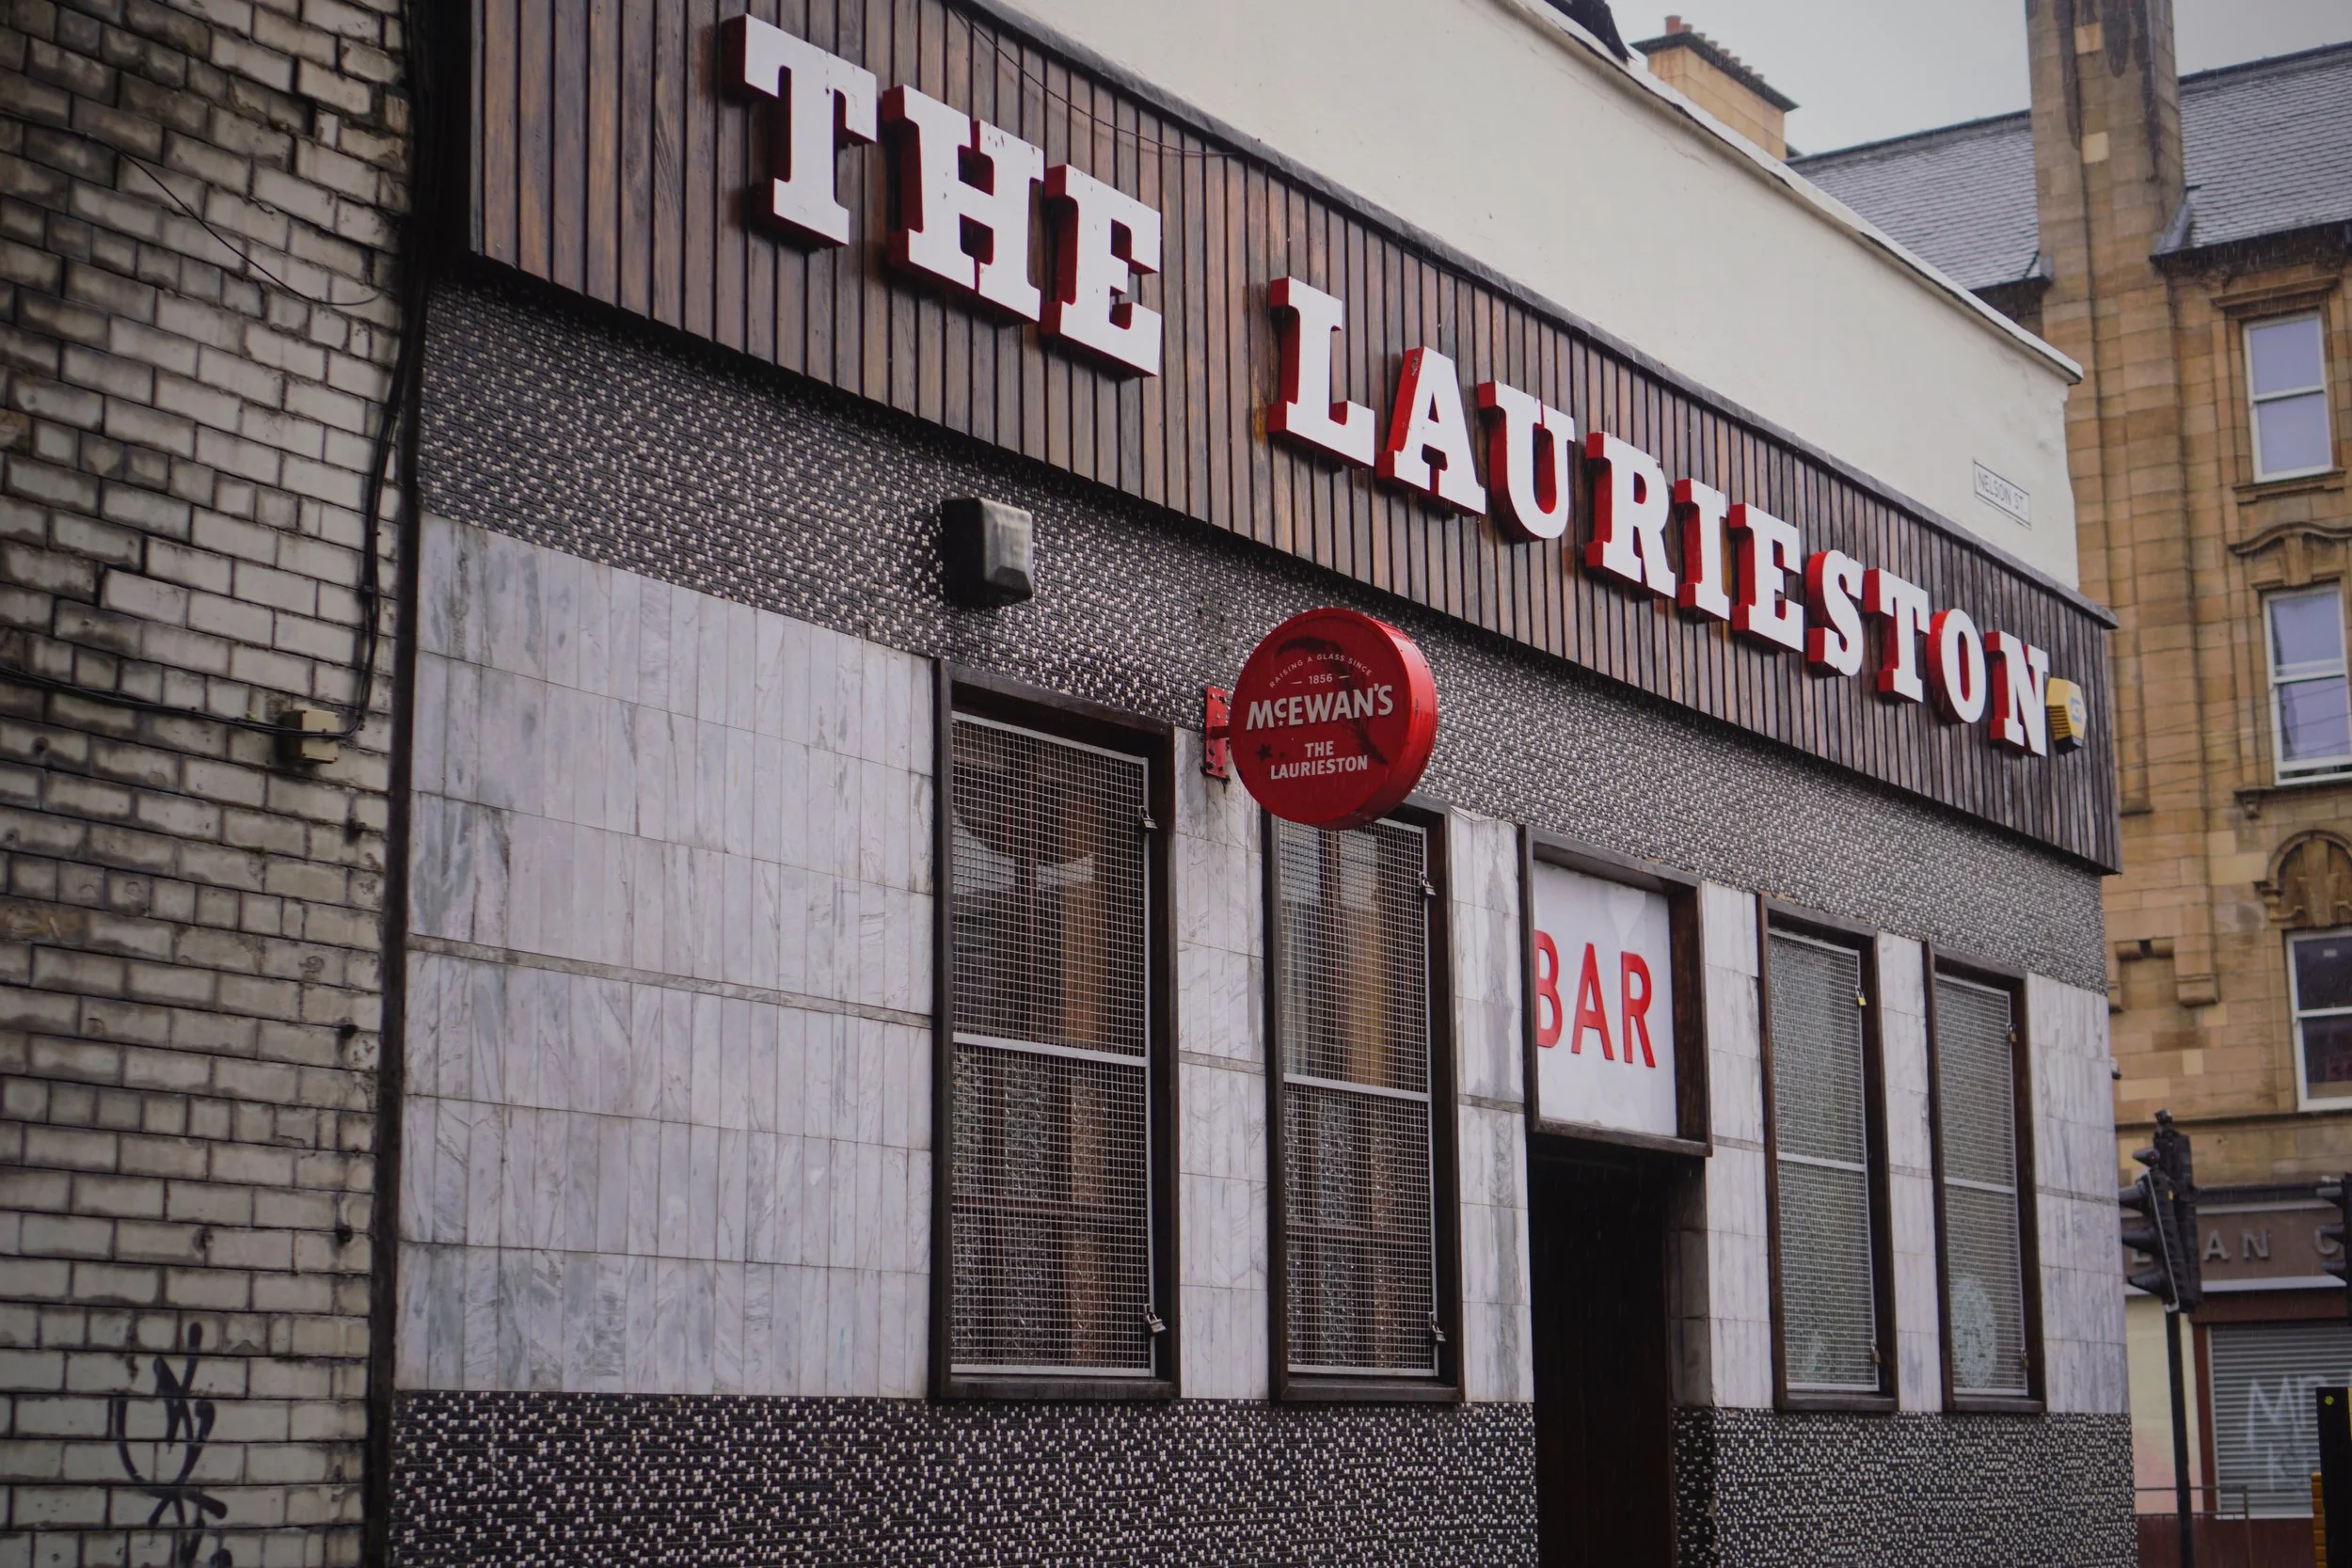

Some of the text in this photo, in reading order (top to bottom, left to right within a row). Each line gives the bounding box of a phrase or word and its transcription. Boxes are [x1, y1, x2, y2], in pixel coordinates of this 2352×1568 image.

[722, 13, 2050, 757] THE LAURIESTON
[1977, 469, 2011, 506] NELSON
[1269, 659, 1304, 689] RAISING
[1316, 653, 1345, 662] GLASS
[1347, 657, 1373, 677] SINCE
[1309, 673, 1333, 685] 1856
[1270, 754, 1368, 780] LAURIESTON
[1304, 740, 1334, 758] THE
[1534, 928, 1656, 1069] BAR
